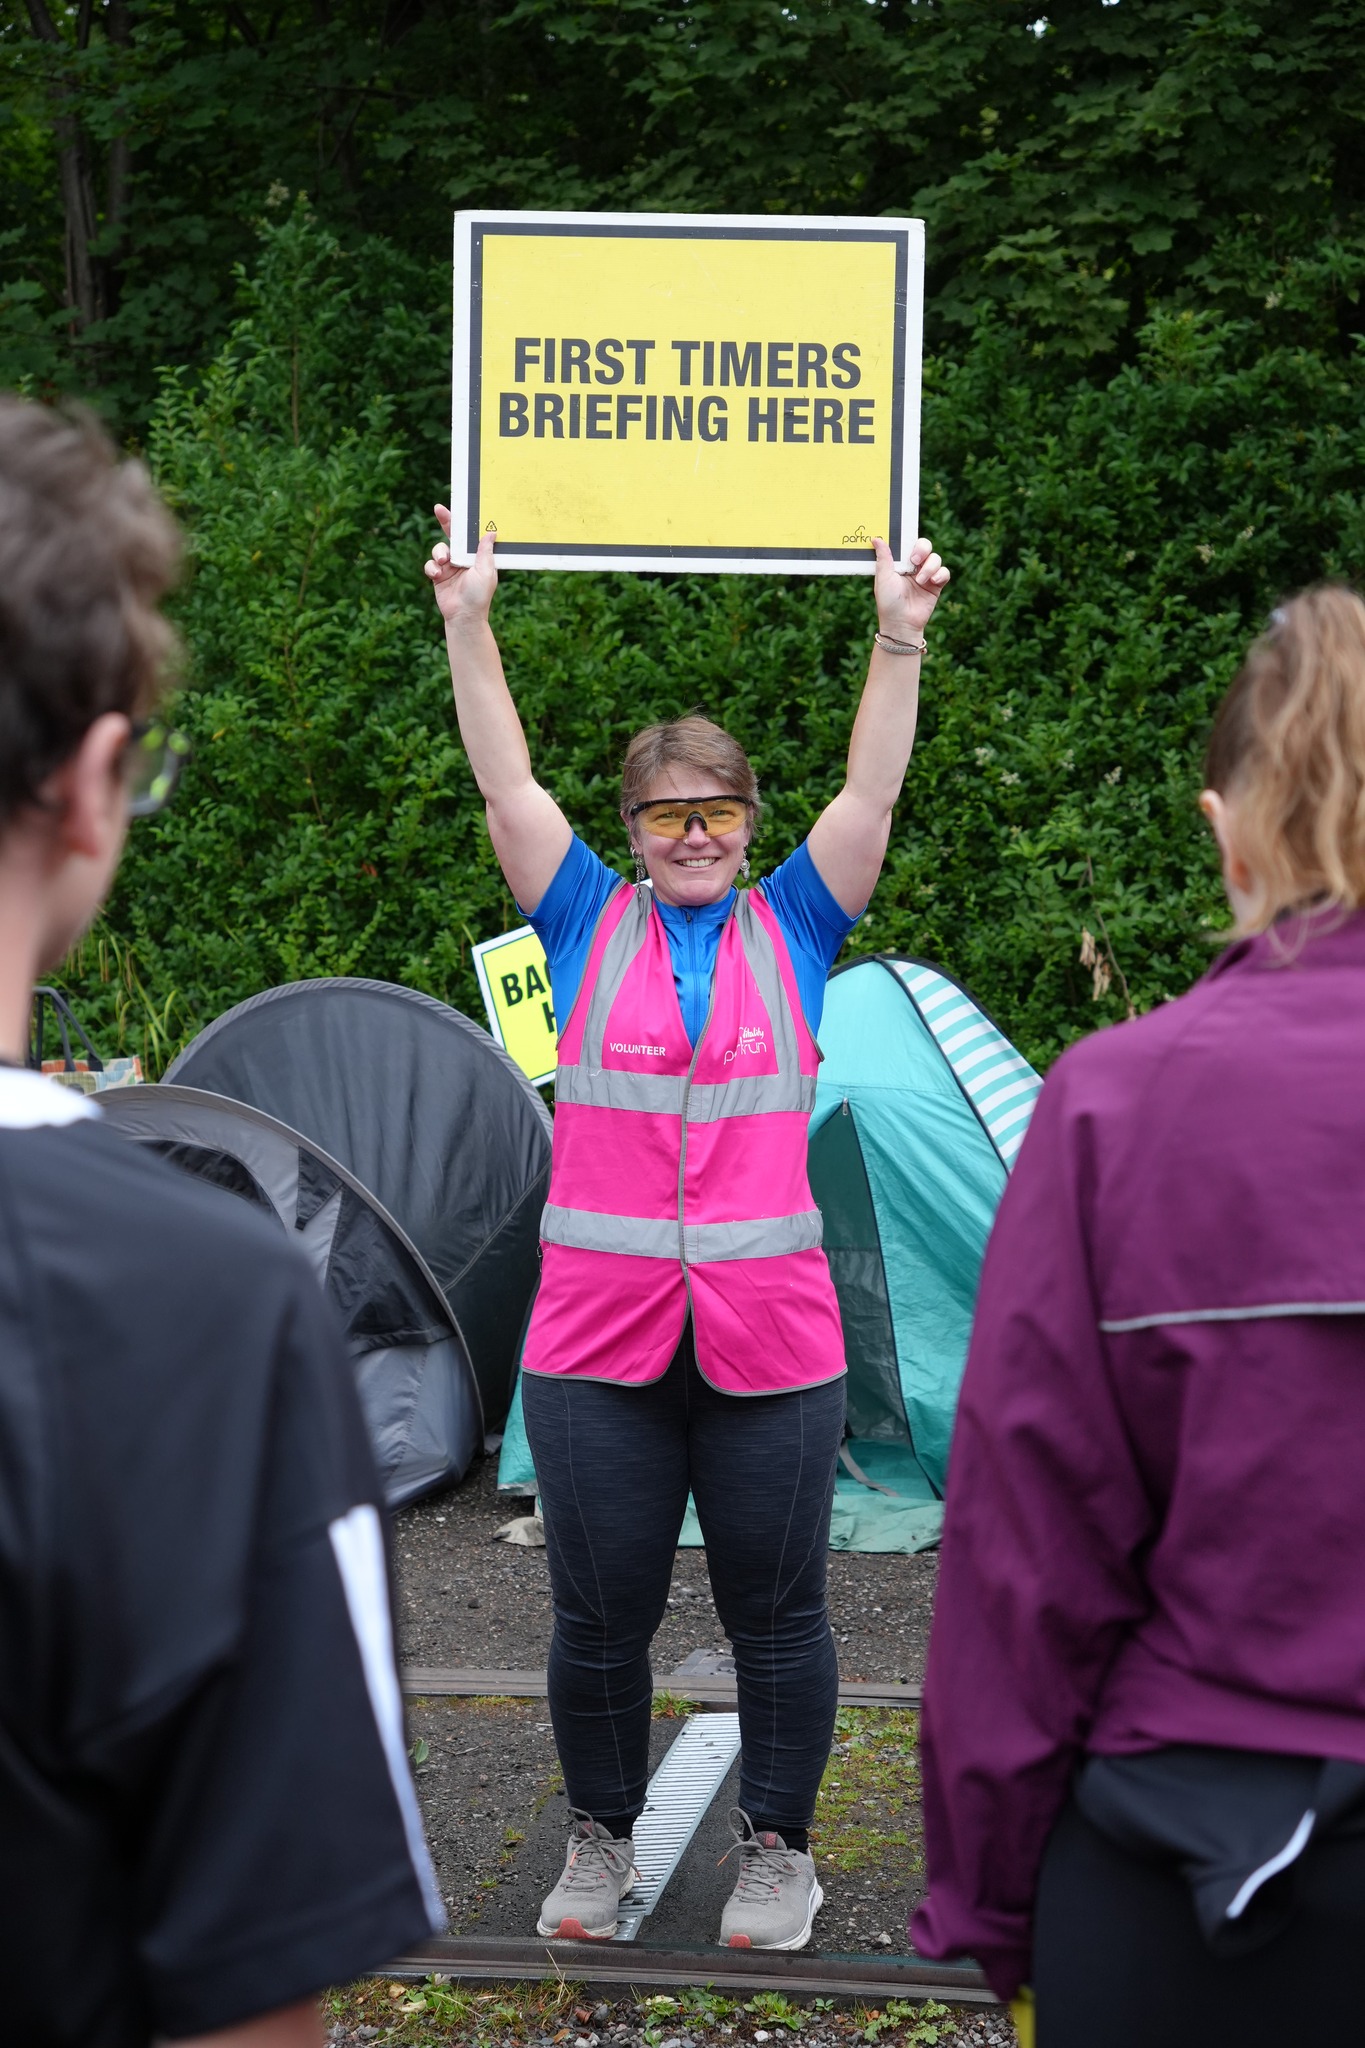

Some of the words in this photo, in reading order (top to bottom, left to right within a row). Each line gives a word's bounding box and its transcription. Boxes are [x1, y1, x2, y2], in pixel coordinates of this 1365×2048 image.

[514, 337, 655, 385] FIRST
[671, 340, 862, 389] TIMERS
[499, 392, 729, 442] BRIEFING
[747, 397, 875, 444] HERE
[842, 525, 883, 545] parkr
[609, 1042, 666, 1057] VOLUNTEER
